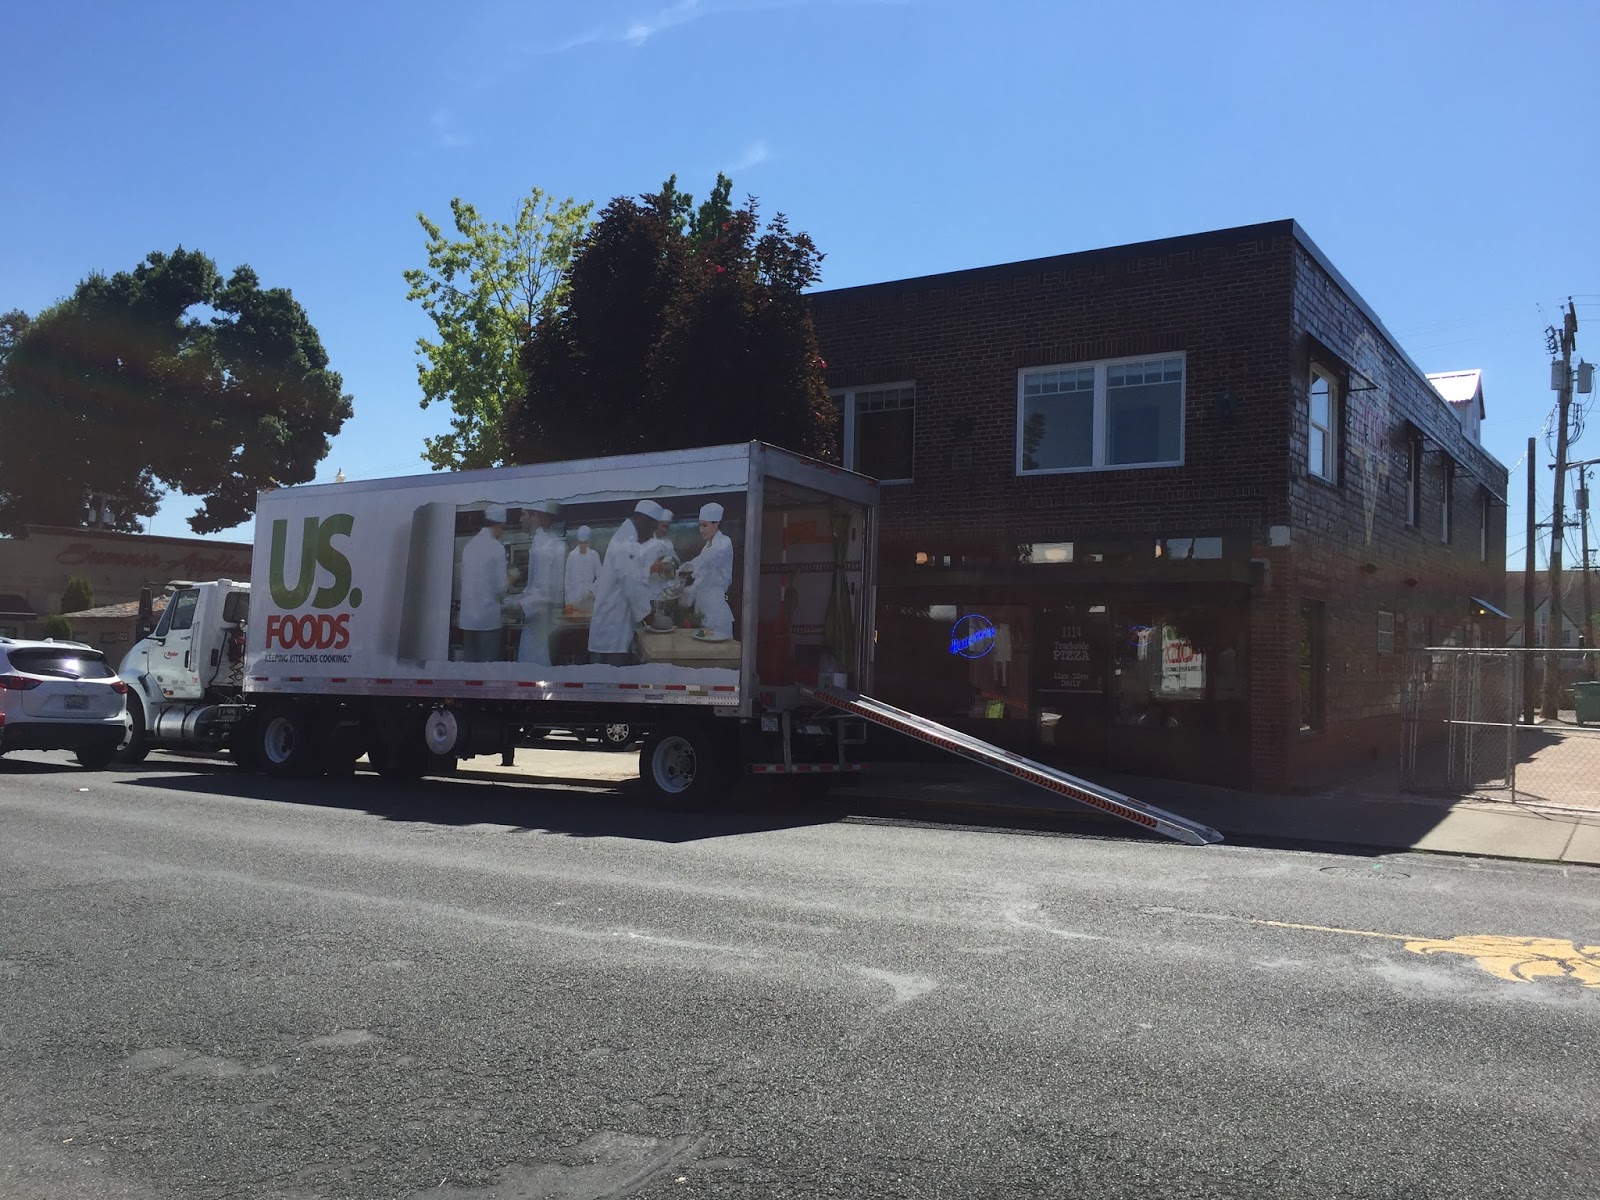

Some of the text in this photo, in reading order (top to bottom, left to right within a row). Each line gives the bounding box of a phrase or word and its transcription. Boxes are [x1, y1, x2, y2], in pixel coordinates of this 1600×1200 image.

[265, 613, 351, 650] FOODS
[264, 654, 288, 663] KEEPING
[289, 654, 318, 663] KITCHENS
[1052, 650, 1090, 661] PIZZA
